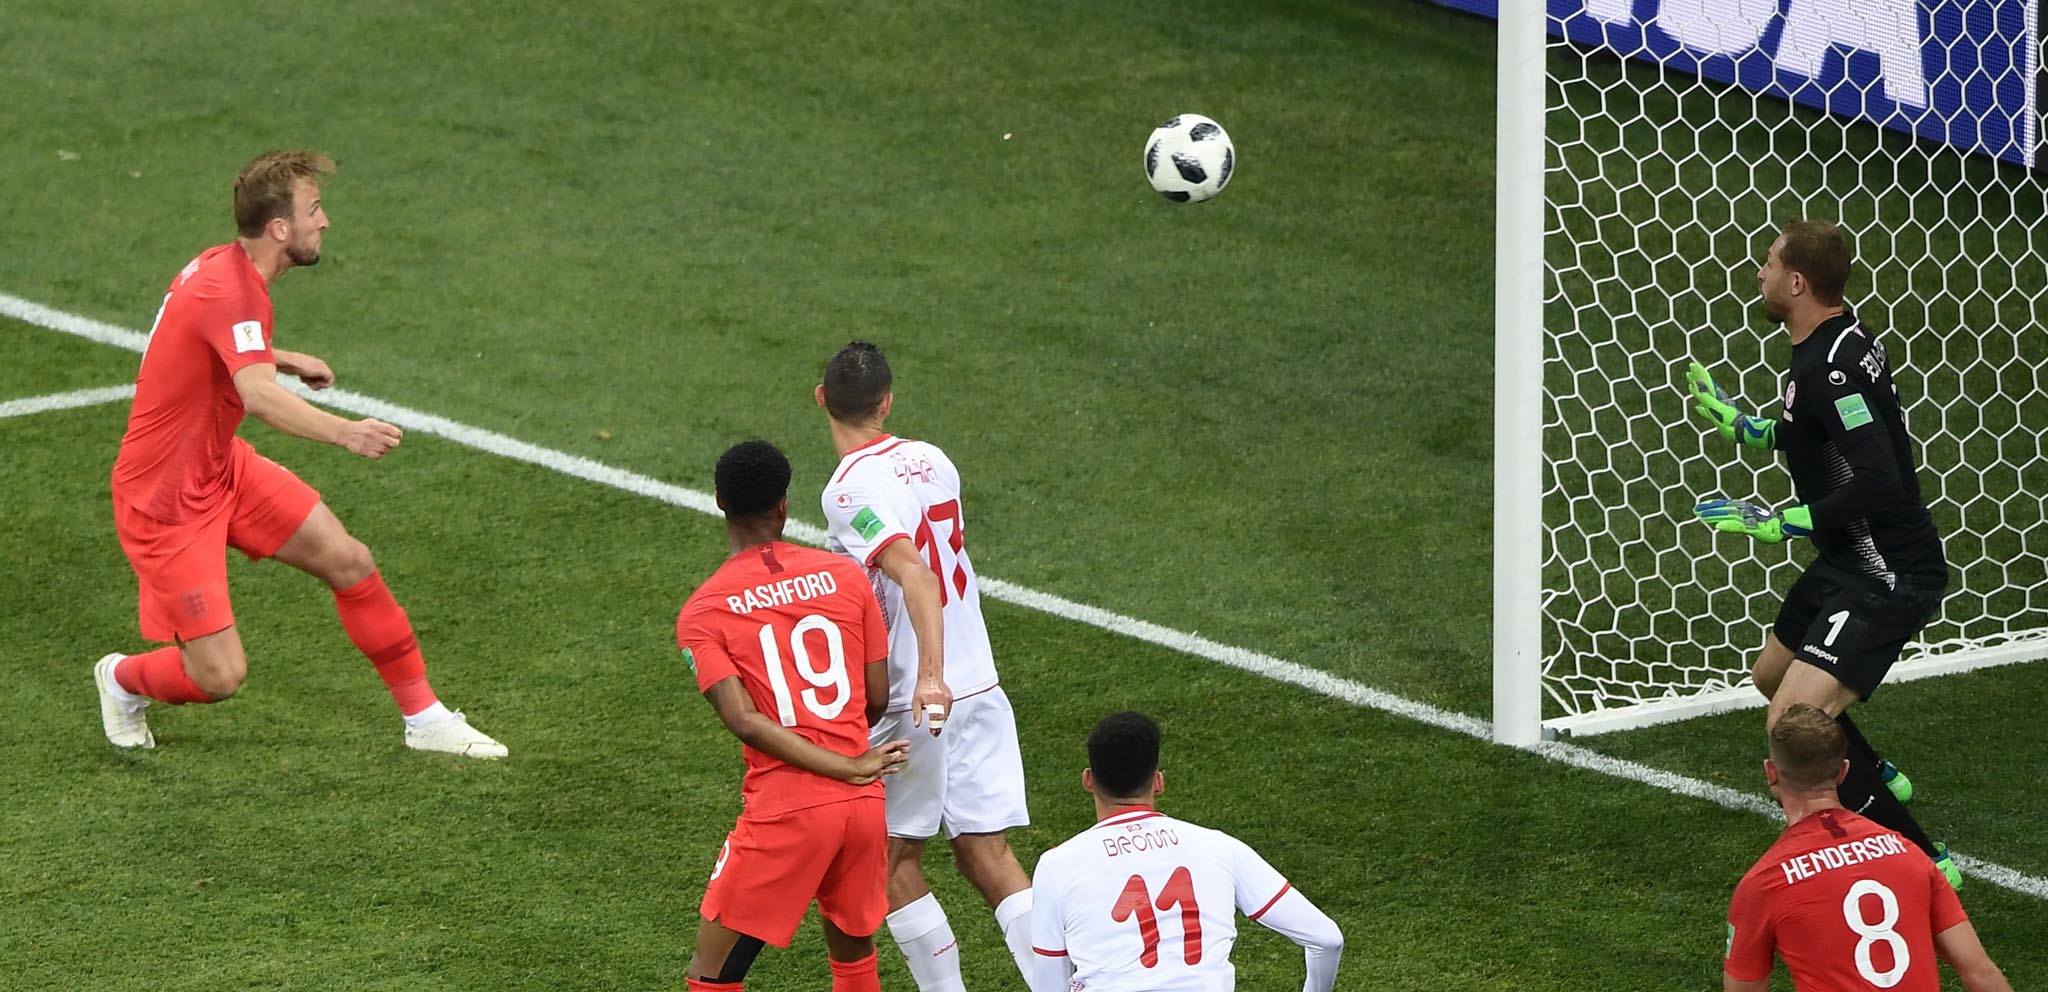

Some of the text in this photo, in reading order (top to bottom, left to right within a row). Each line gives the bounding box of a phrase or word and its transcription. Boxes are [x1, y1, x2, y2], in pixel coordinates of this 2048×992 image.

[914, 498, 968, 608] 17
[726, 571, 837, 615] RASHFORD
[1823, 610, 1850, 647] 1
[758, 614, 851, 727] 19
[1103, 828, 1179, 857] BRONN
[1780, 833, 1908, 885] HENDERSON
[1111, 866, 1202, 968] 11
[1843, 879, 1910, 988] 8
